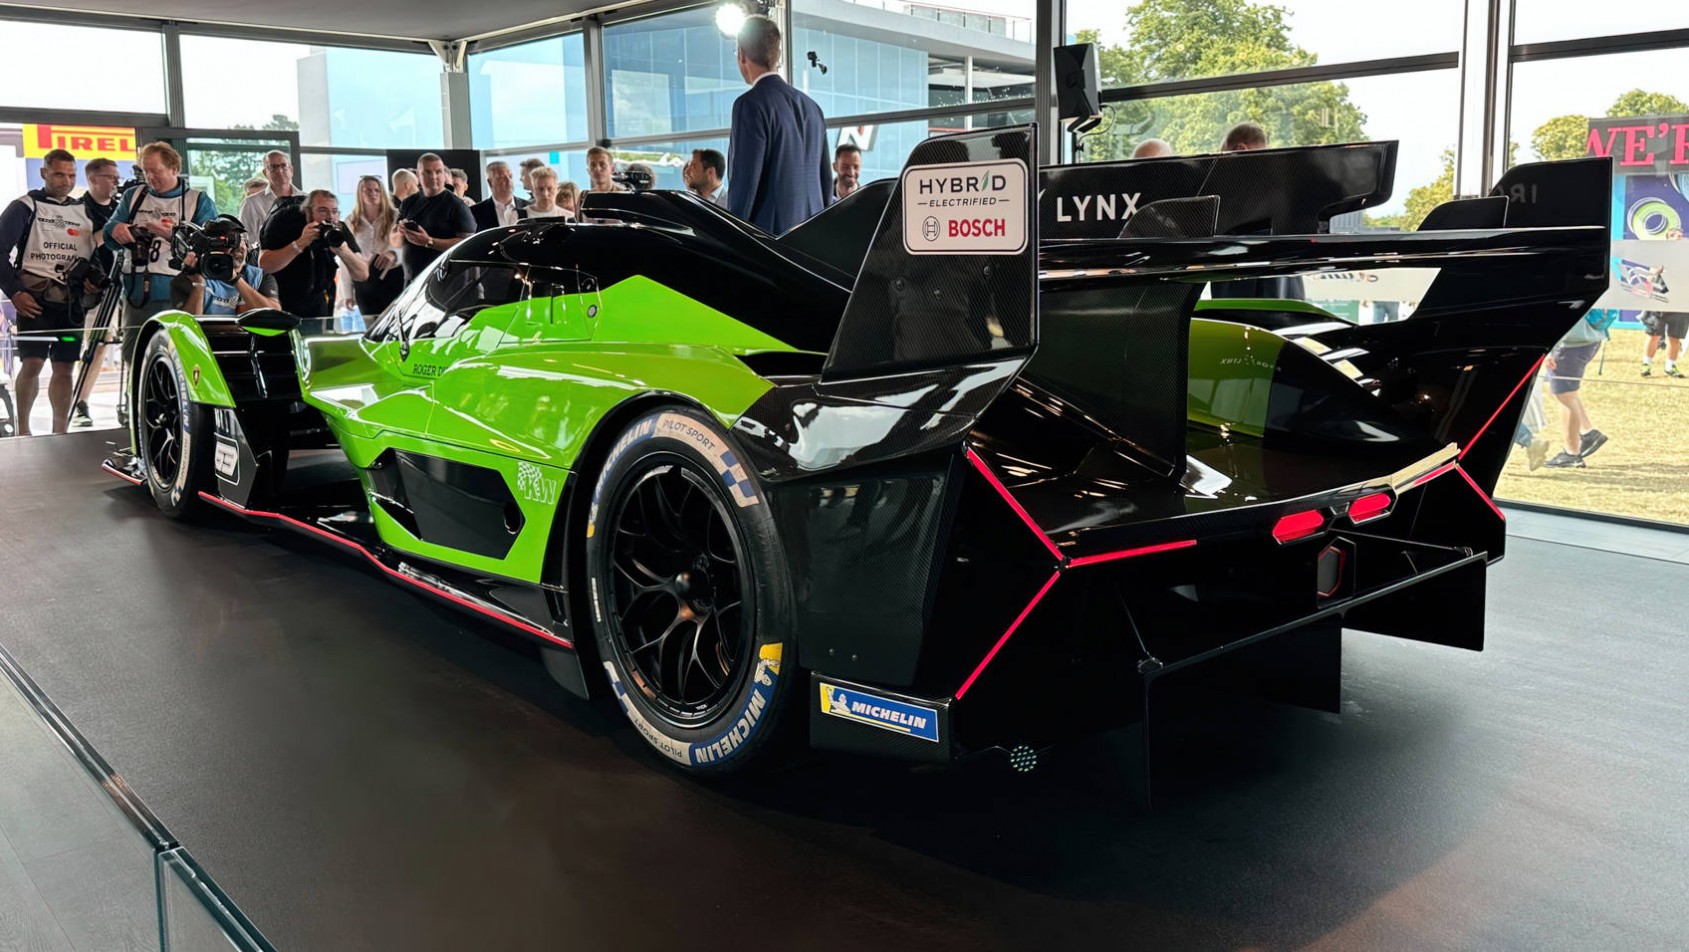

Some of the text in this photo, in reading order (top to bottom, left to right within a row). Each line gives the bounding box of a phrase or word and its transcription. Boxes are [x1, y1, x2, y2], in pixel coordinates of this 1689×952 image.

[920, 170, 1007, 194] HYBRID
[929, 197, 997, 207] ELECTRIFIED
[1057, 192, 1141, 222] LYNX
[948, 218, 1006, 238] BOSCH
[43, 241, 78, 251] OFFICIAL
[413, 364, 436, 377] ROGER
[663, 419, 716, 450] PILOT SPORT
[694, 688, 766, 764] MICHELIN
[851, 701, 927, 729] MICHELIN
[660, 741, 683, 758] PILOT
